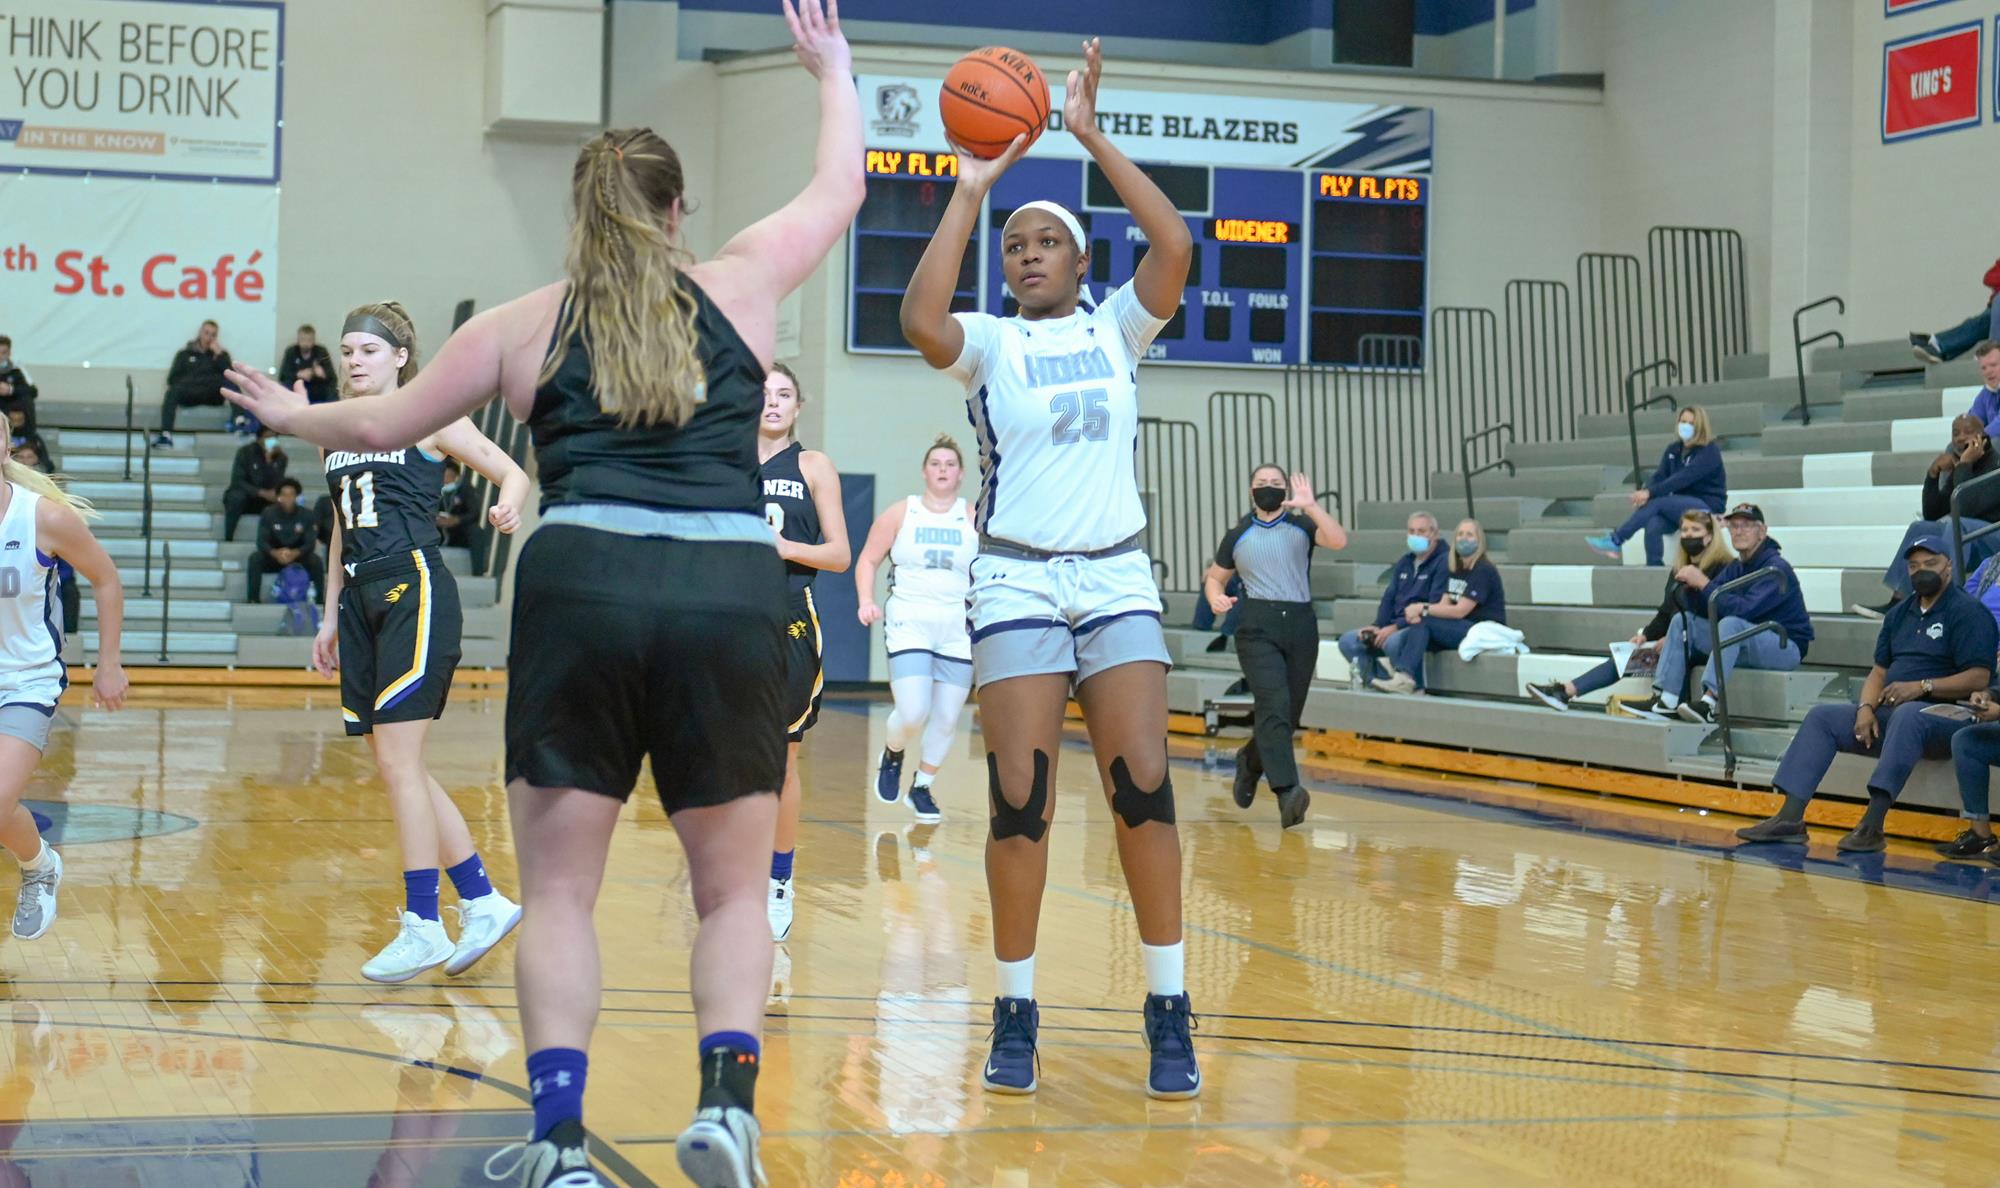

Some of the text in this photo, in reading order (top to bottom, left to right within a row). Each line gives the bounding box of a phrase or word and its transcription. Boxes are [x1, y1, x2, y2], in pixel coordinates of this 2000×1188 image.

[119, 21, 270, 71] BEFORE
[13, 66, 240, 119] YOU DRINK
[1910, 65, 1952, 100] KING'S
[23, 130, 44, 144] IN
[50, 132, 87, 146] THE
[94, 133, 157, 149] KNOW
[1095, 112, 1153, 136] THE
[1163, 115, 1299, 144] BLAZERS
[866, 151, 958, 177] PLY FL PT
[1321, 175, 1420, 201] PLY FL PTS
[1215, 219, 1288, 243] WIDENER
[2, 243, 265, 302] th St. Café
[1202, 290, 1235, 307] T.O.L.
[1248, 292, 1289, 310] FOULS
[1252, 347, 1282, 363] WON
[1050, 388, 1110, 446] 25
[339, 471, 379, 530] 11
[915, 527, 962, 546] HOOD
